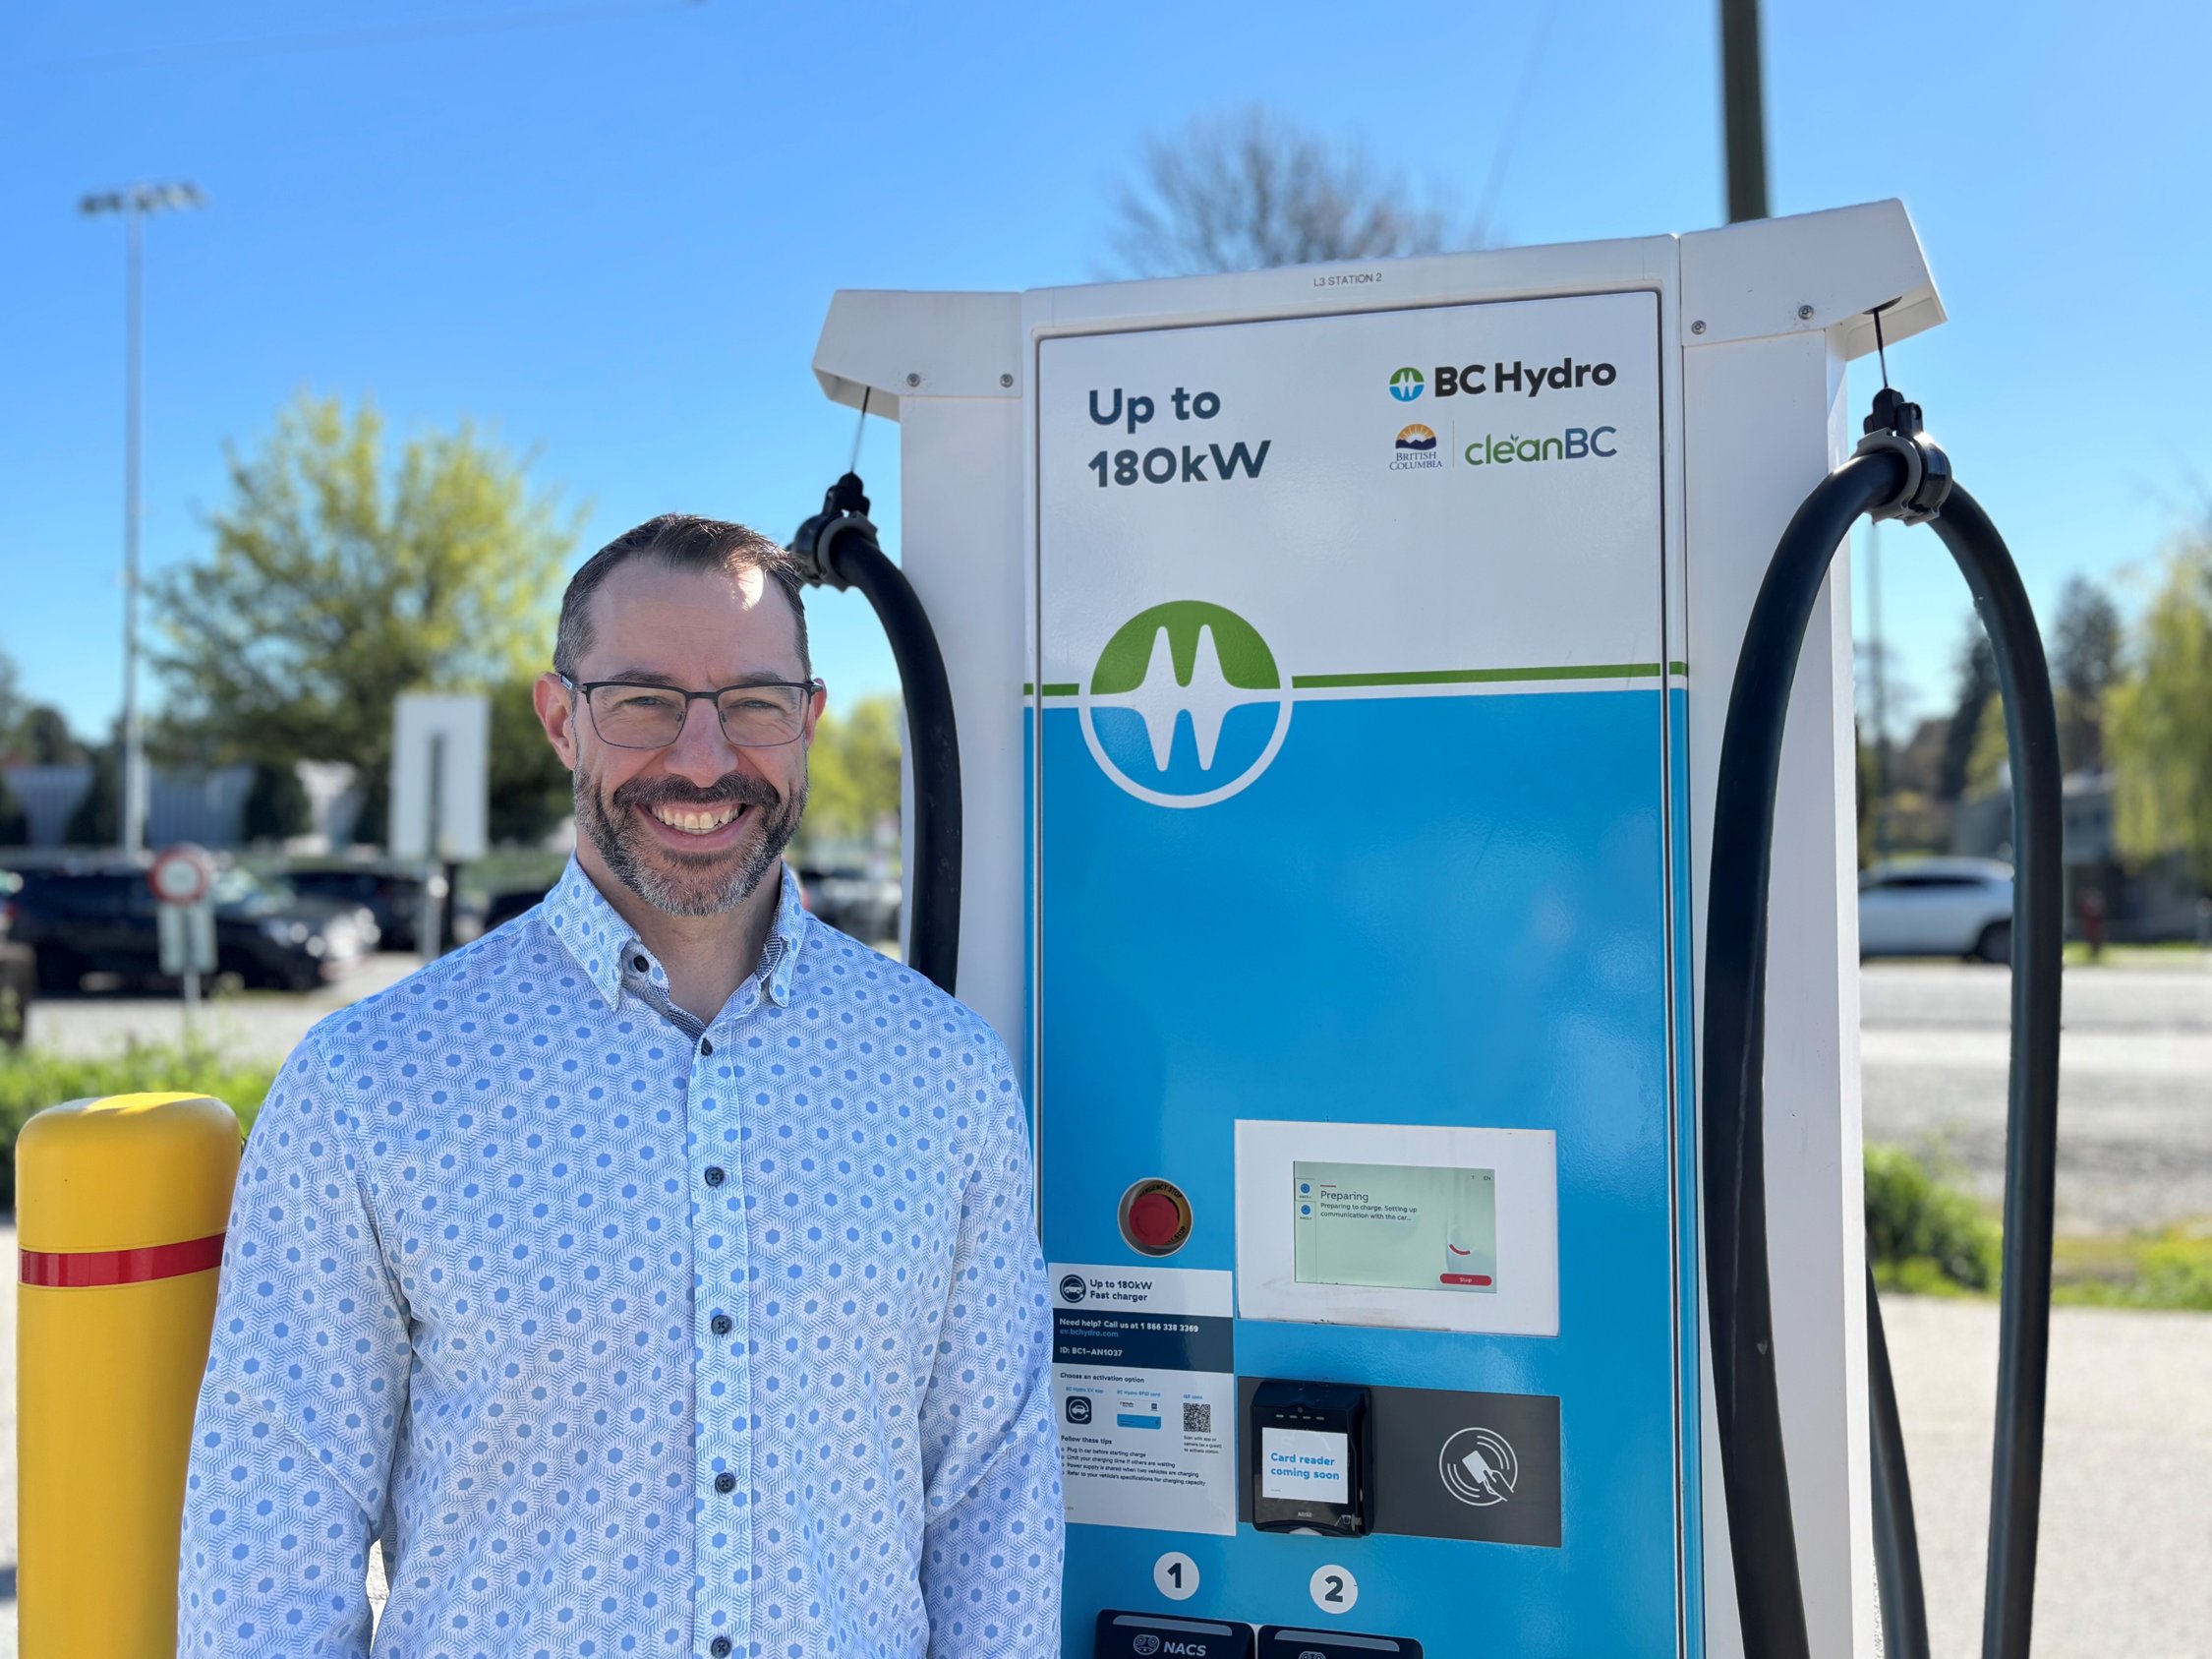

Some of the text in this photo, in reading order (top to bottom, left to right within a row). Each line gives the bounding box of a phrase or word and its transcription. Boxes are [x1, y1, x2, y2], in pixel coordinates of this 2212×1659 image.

[1314, 273, 1382, 287] L3 STATION 2
[1435, 357, 1617, 397] BC Hydro
[1089, 387, 1221, 434] Up to
[1465, 426, 1617, 466] cleanBC
[1396, 451, 1437, 461] BRITISH
[1088, 440, 1272, 487] 180kW
[1389, 460, 1442, 470] COLUMBIA
[1321, 1190, 1369, 1203] Preparing
[1090, 1279, 1103, 1289] Up
[1117, 1281, 1153, 1290] 180kW
[1090, 1290, 1148, 1302] Fast charger
[1082, 1319, 1101, 1328] help?
[1060, 1329, 1118, 1337] ev.bchydro.com
[1072, 1347, 1123, 1357] BC1-AN1037
[1271, 1452, 1335, 1465] Card reader
[1271, 1467, 1339, 1480] coming soon
[1167, 1562, 1182, 1588] 1
[1325, 1575, 1343, 1602] 2
[1164, 1641, 1206, 1657] NACS
